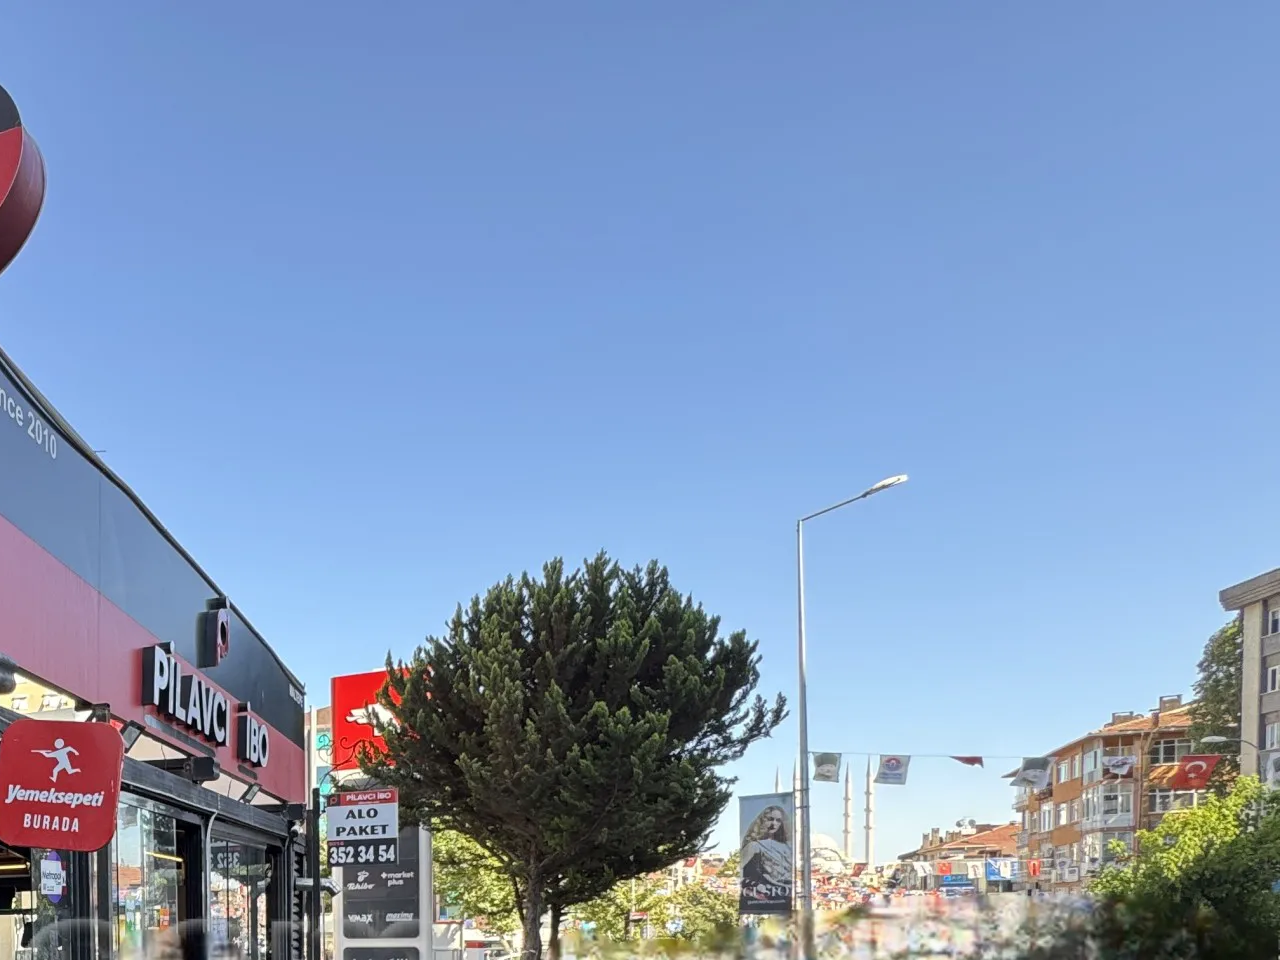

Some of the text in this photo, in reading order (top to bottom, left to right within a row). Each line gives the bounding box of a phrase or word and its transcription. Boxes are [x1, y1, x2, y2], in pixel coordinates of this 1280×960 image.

[27, 411, 57, 459] 2010
[153, 640, 269, 767] PİLAVCI İBO
[5, 784, 105, 808] Yemeksepeti
[23, 813, 79, 832] BURADA
[345, 807, 379, 820] ALO
[335, 824, 389, 837] PAKET
[329, 844, 396, 864] 352 34 54
